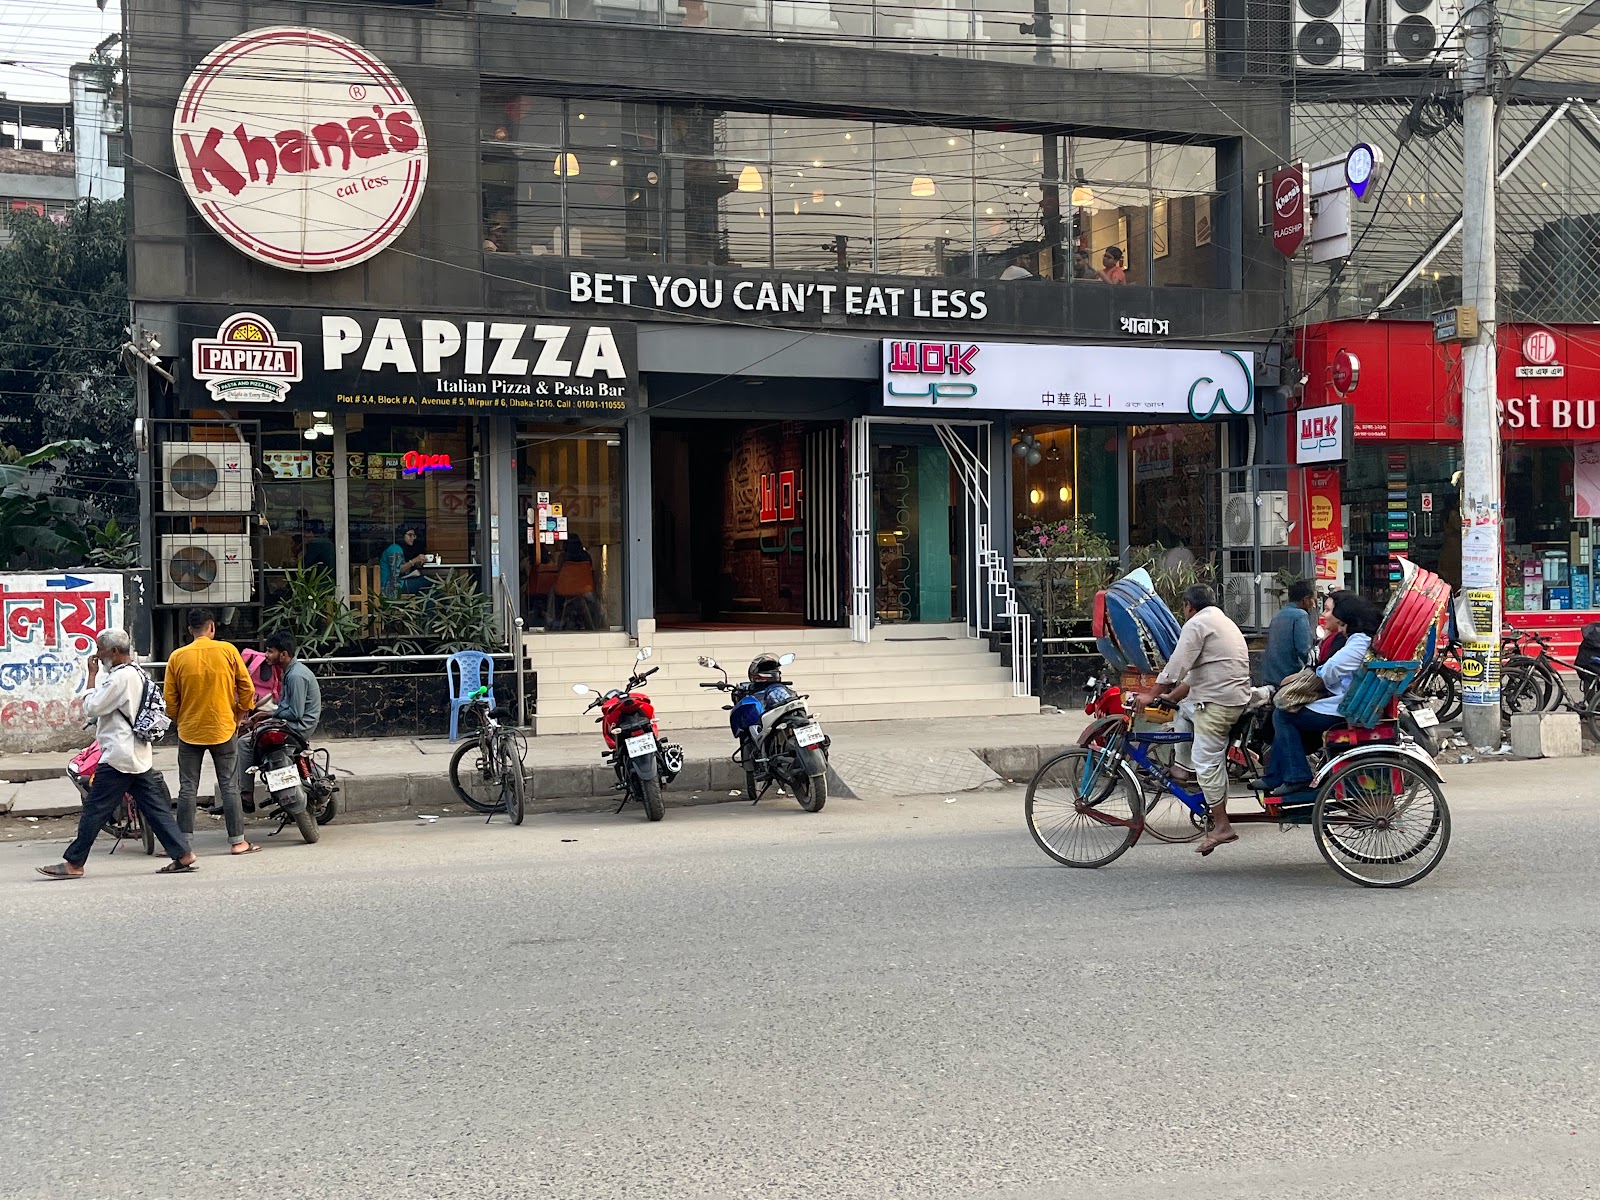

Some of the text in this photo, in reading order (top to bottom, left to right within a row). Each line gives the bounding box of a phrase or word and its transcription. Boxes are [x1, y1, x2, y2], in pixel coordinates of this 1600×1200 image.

[181, 105, 419, 197] Khana's
[337, 175, 389, 198] eat less
[1274, 223, 1303, 239] FLAGSHIP
[570, 271, 988, 319] BET YOU CAN'T EAT LESS
[321, 316, 627, 379] PAPIZZA
[889, 341, 980, 375] WOK
[209, 348, 286, 371] PAPIZZA
[221, 382, 237, 390] PASTA
[436, 378, 626, 397] Italian Pizza & Pasta Bar
[337, 394, 353, 403] Plot
[355, 395, 361, 403] #
[378, 395, 400, 404] Block
[402, 396, 408, 404] #
[421, 396, 450, 405] Avenue
[452, 397, 457, 405] #
[468, 398, 492, 408] Mirpur
[494, 398, 499, 406] #
[557, 400, 571, 408] Call
[1042, 390, 1103, 408] 中華鍋上
[1301, 415, 1338, 440] WOK
[403, 450, 451, 475] Open
[1463, 662, 1480, 671] AIM
